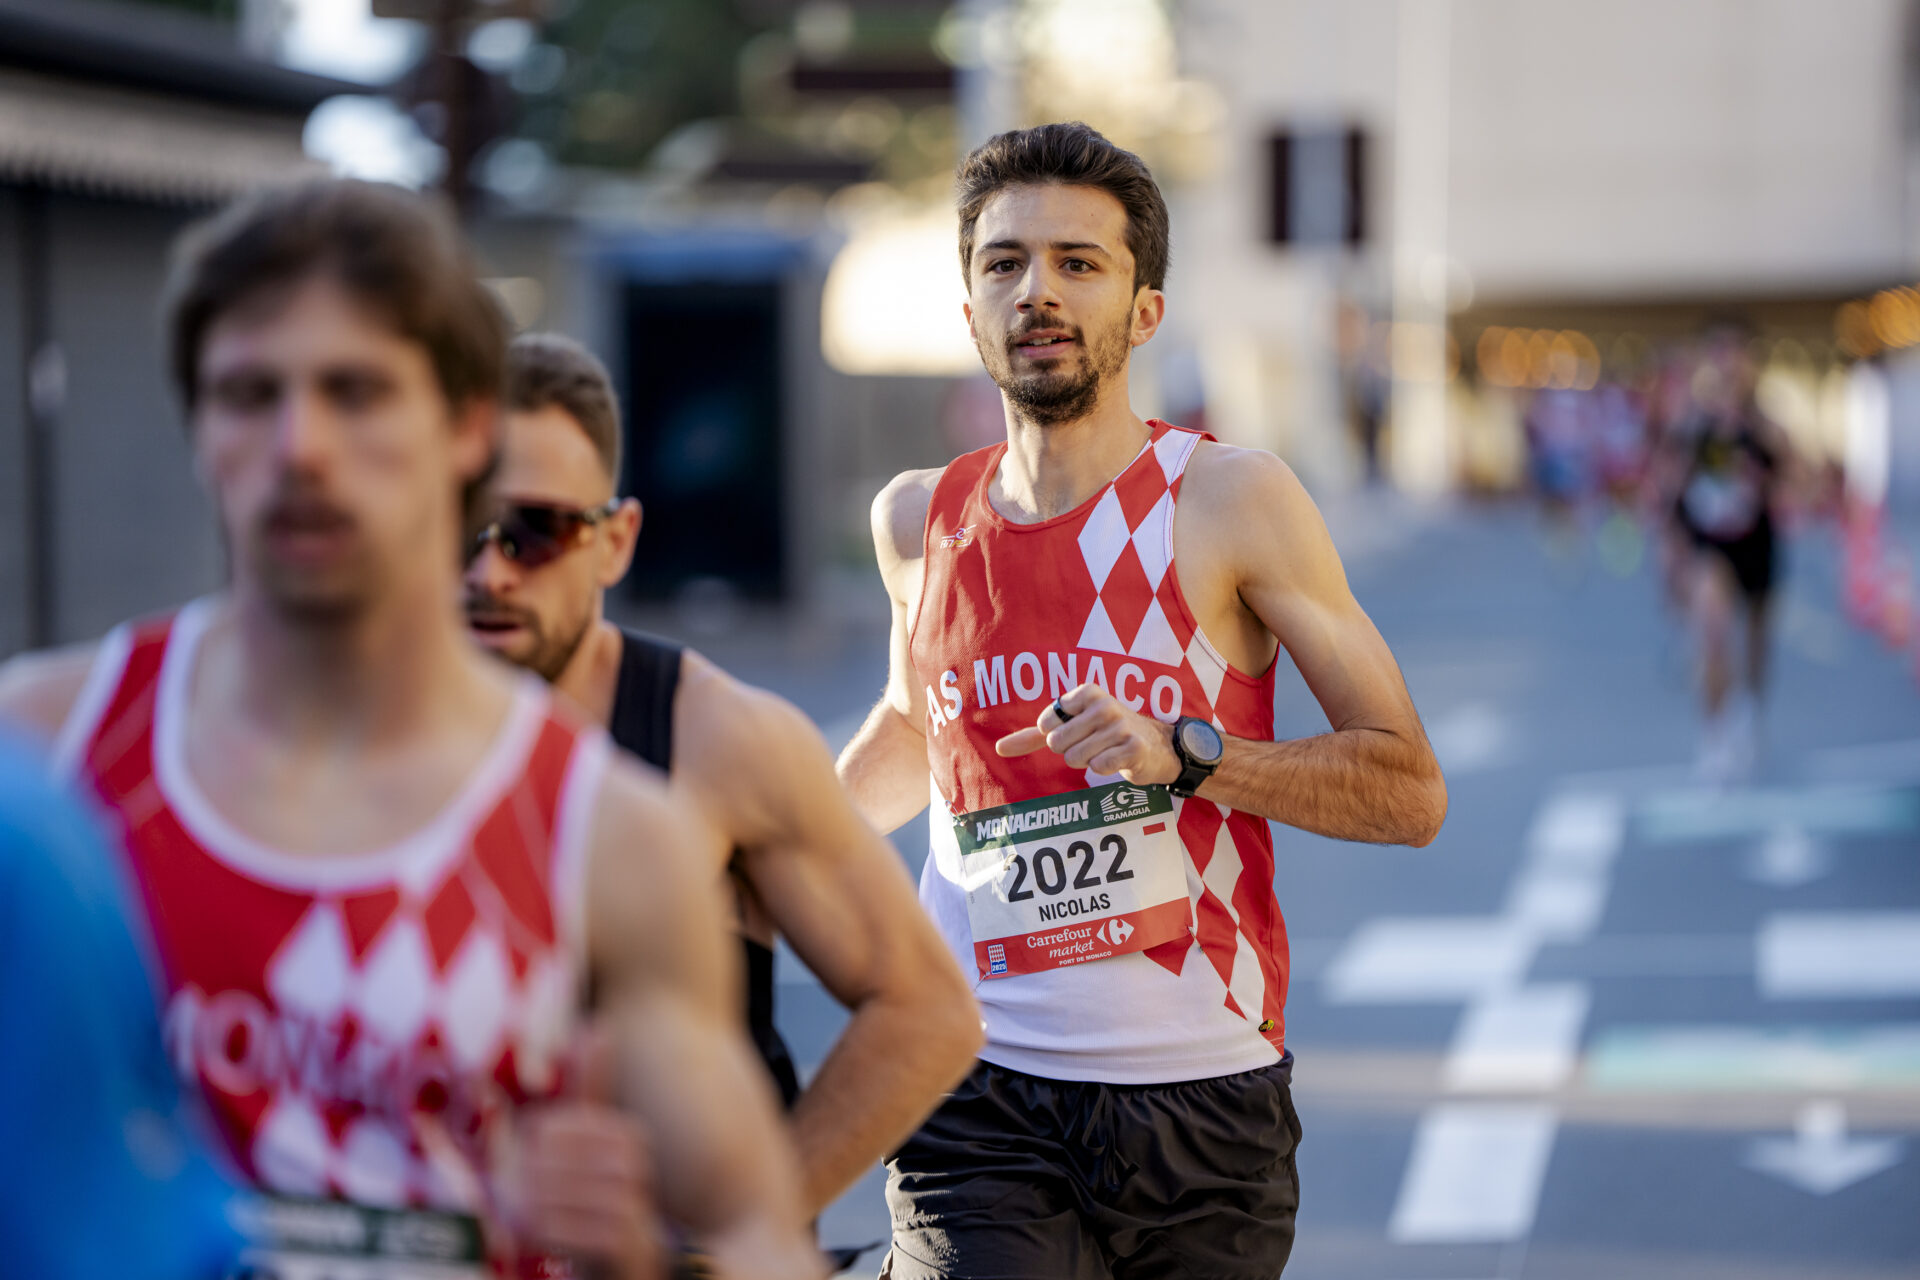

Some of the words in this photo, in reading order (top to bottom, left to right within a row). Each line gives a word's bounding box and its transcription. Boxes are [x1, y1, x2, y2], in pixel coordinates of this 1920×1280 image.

[926, 670, 963, 737] AS
[973, 651, 1183, 724] MONACO
[976, 799, 1090, 842] MONACORUN
[1103, 806, 1151, 823] GRAMAGLIA
[1003, 833, 1135, 903] 2022
[1038, 893, 1111, 922] NICOLAS
[1026, 926, 1092, 949] Carrefour
[1049, 938, 1095, 959] market
[1058, 957, 1075, 966] PORT
[1085, 950, 1112, 961] MONACO
